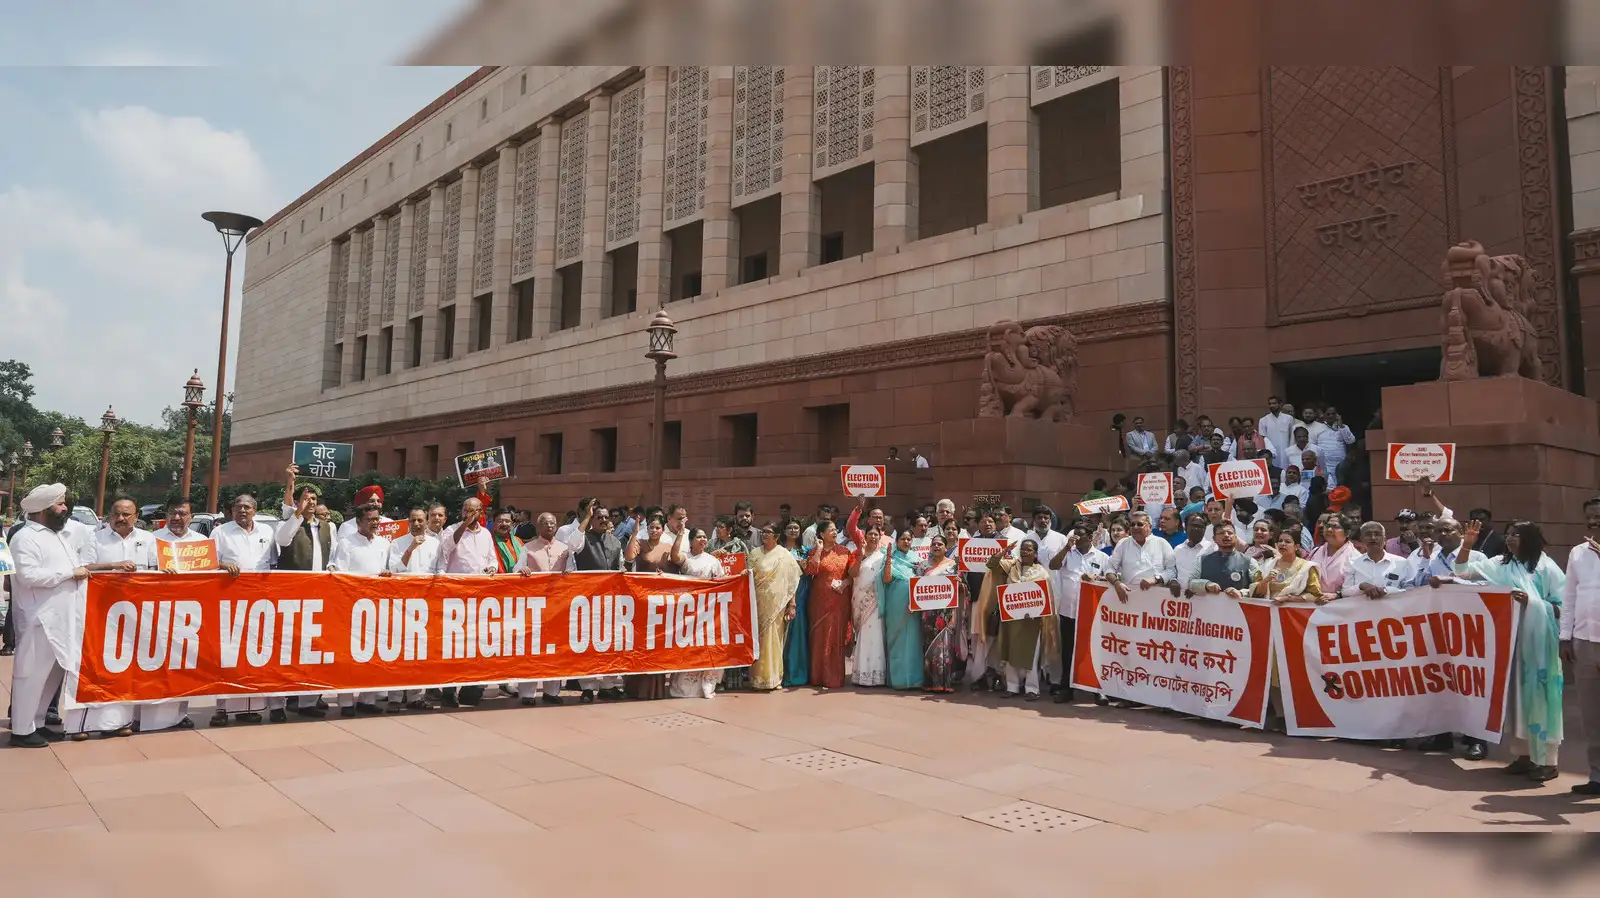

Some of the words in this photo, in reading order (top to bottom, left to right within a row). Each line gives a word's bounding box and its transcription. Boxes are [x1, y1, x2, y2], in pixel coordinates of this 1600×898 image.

[1296, 161, 1417, 206] सत्यमेव
[1315, 205, 1400, 244] जयते
[312, 443, 336, 459] वोट
[309, 460, 337, 477] चोरी
[1217, 469, 1260, 482] ELECTION
[847, 474, 879, 482] ELECTION
[1219, 479, 1262, 490] COMMISSION
[964, 546, 1001, 556] ELECTION
[916, 584, 952, 594] ELECTION
[916, 593, 952, 601] COMMISSION
[1005, 590, 1042, 602] ELECTION
[1006, 600, 1044, 610] COMMISSION
[1161, 599, 1193, 618] (SIR)
[103, 600, 202, 673] OUR
[219, 599, 335, 668] VOTE.
[350, 598, 429, 663] OUR
[442, 596, 556, 660] RIGHT.
[568, 595, 635, 653] OUR
[646, 591, 745, 650] FIGHT.
[1101, 605, 1139, 628] SILENT
[1142, 612, 1194, 635] INVISIBLE
[1195, 618, 1244, 642] RIGGING
[1316, 612, 1486, 664] ELECTION
[1101, 632, 1130, 656] वोट
[1136, 639, 1176, 664] चोरी
[1179, 644, 1199, 670] बंद
[1203, 650, 1237, 674] करो
[1101, 662, 1124, 681] চুপি
[1126, 667, 1150, 686] চুপি
[1152, 674, 1188, 693] ভোটের
[1321, 661, 1486, 699] COMMISSION
